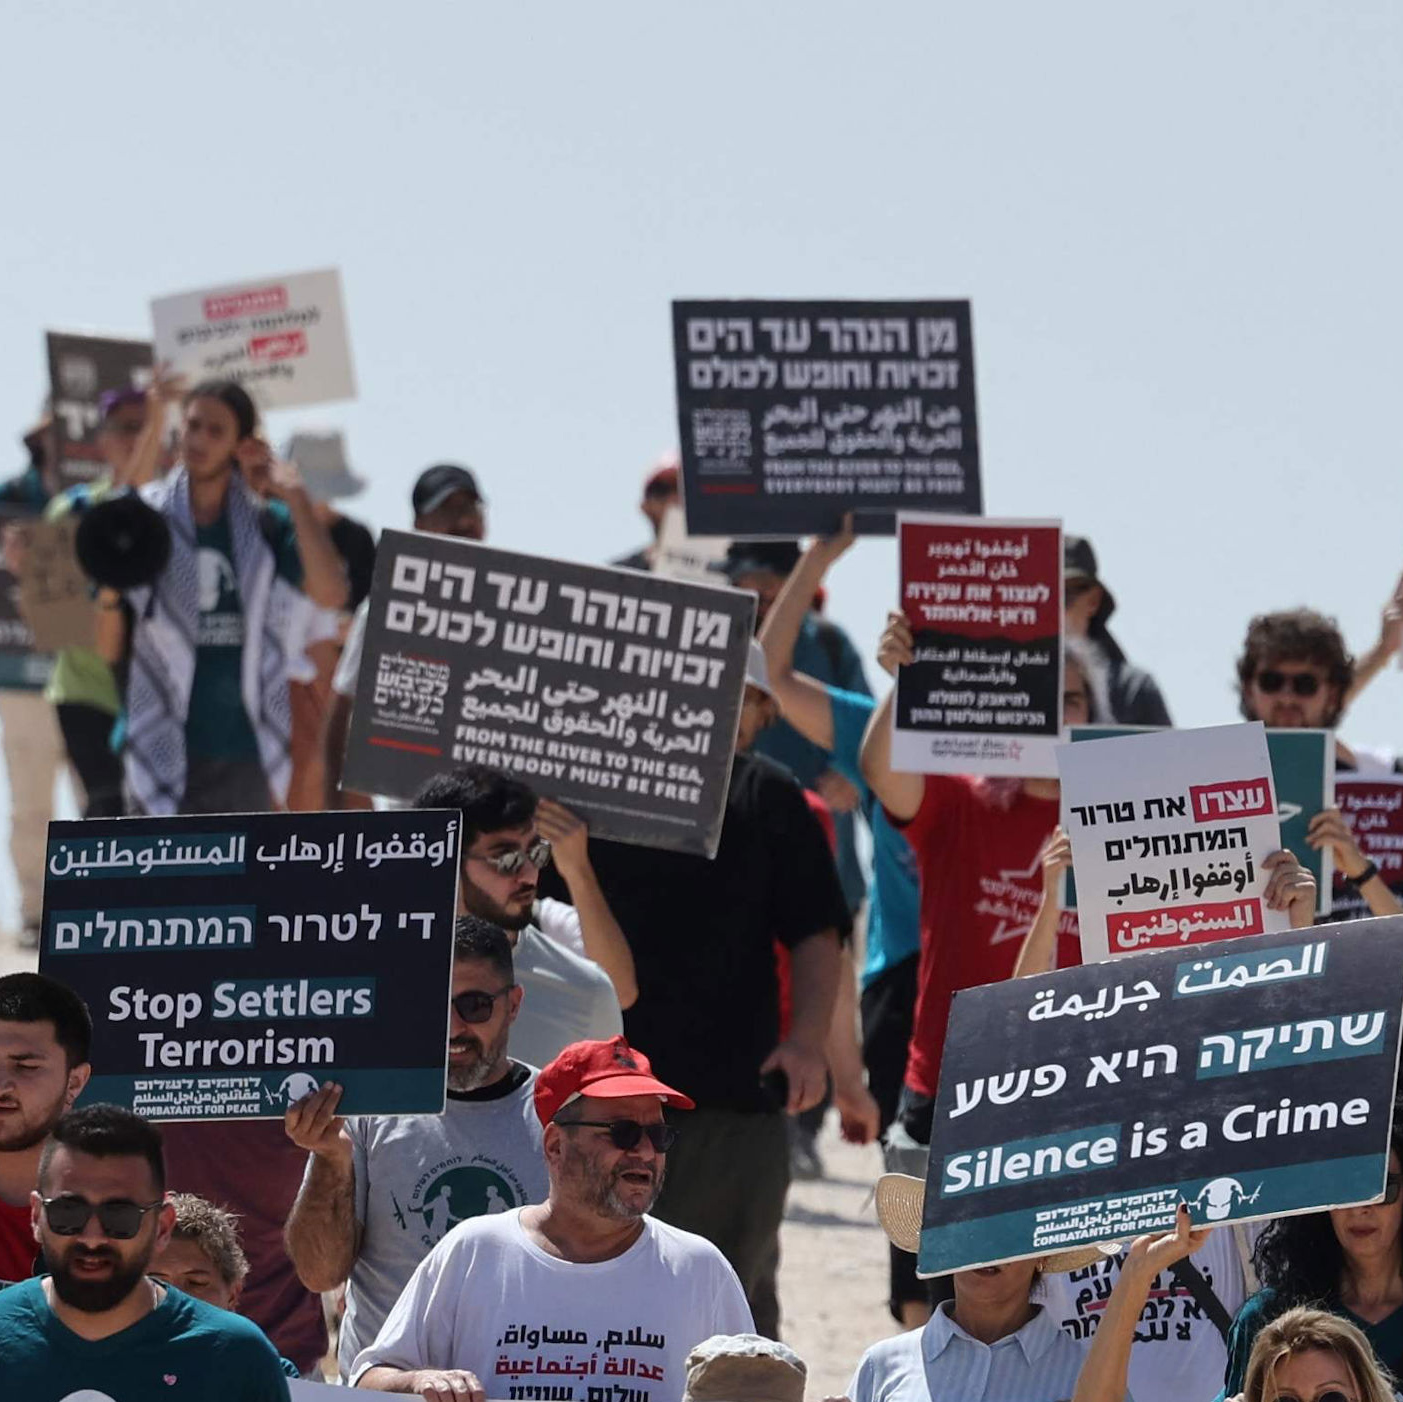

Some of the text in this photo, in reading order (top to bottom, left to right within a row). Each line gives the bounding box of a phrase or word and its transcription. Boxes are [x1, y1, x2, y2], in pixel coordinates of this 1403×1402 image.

[392, 555, 731, 650] מן הנהר עד הים
[385, 600, 726, 689] זכויות וחופש לכולם
[460, 695, 540, 724] للجميع
[464, 665, 715, 728] من النهر حتى البحر
[543, 708, 637, 748] والحقوق
[642, 721, 711, 755] الحرية
[452, 744, 701, 804] EVERYBODY MUST BE FREE
[456, 725, 704, 785] FROM THE RIVER TO THE SEA,
[1071, 786, 1264, 826] עצרו את טרור
[50, 820, 458, 876] أوقفوا إرهاب المستوطنين
[1105, 827, 1248, 862] המתנחלים
[1107, 867, 1179, 901] إرهاب
[1184, 852, 1255, 896] أوقفوا
[55, 904, 435, 950] די לטרור המתנחלים
[1117, 905, 1253, 948] المستوطنين
[1027, 942, 1326, 1022] الصمت جريمة
[108, 980, 372, 1028] Stop Settlers
[138, 1029, 335, 1068] Terrorism
[949, 1010, 1384, 1118] שתיקה היא פשע
[133, 1103, 260, 1116] COMBATANTS FOR PEACE
[944, 1097, 1370, 1192] Silence is a Crime
[1035, 1189, 1178, 1222] לוחמים לשלום
[1033, 1214, 1176, 1247] COMBATANTS FOR PEACE
[604, 1357, 664, 1381] عدالة
